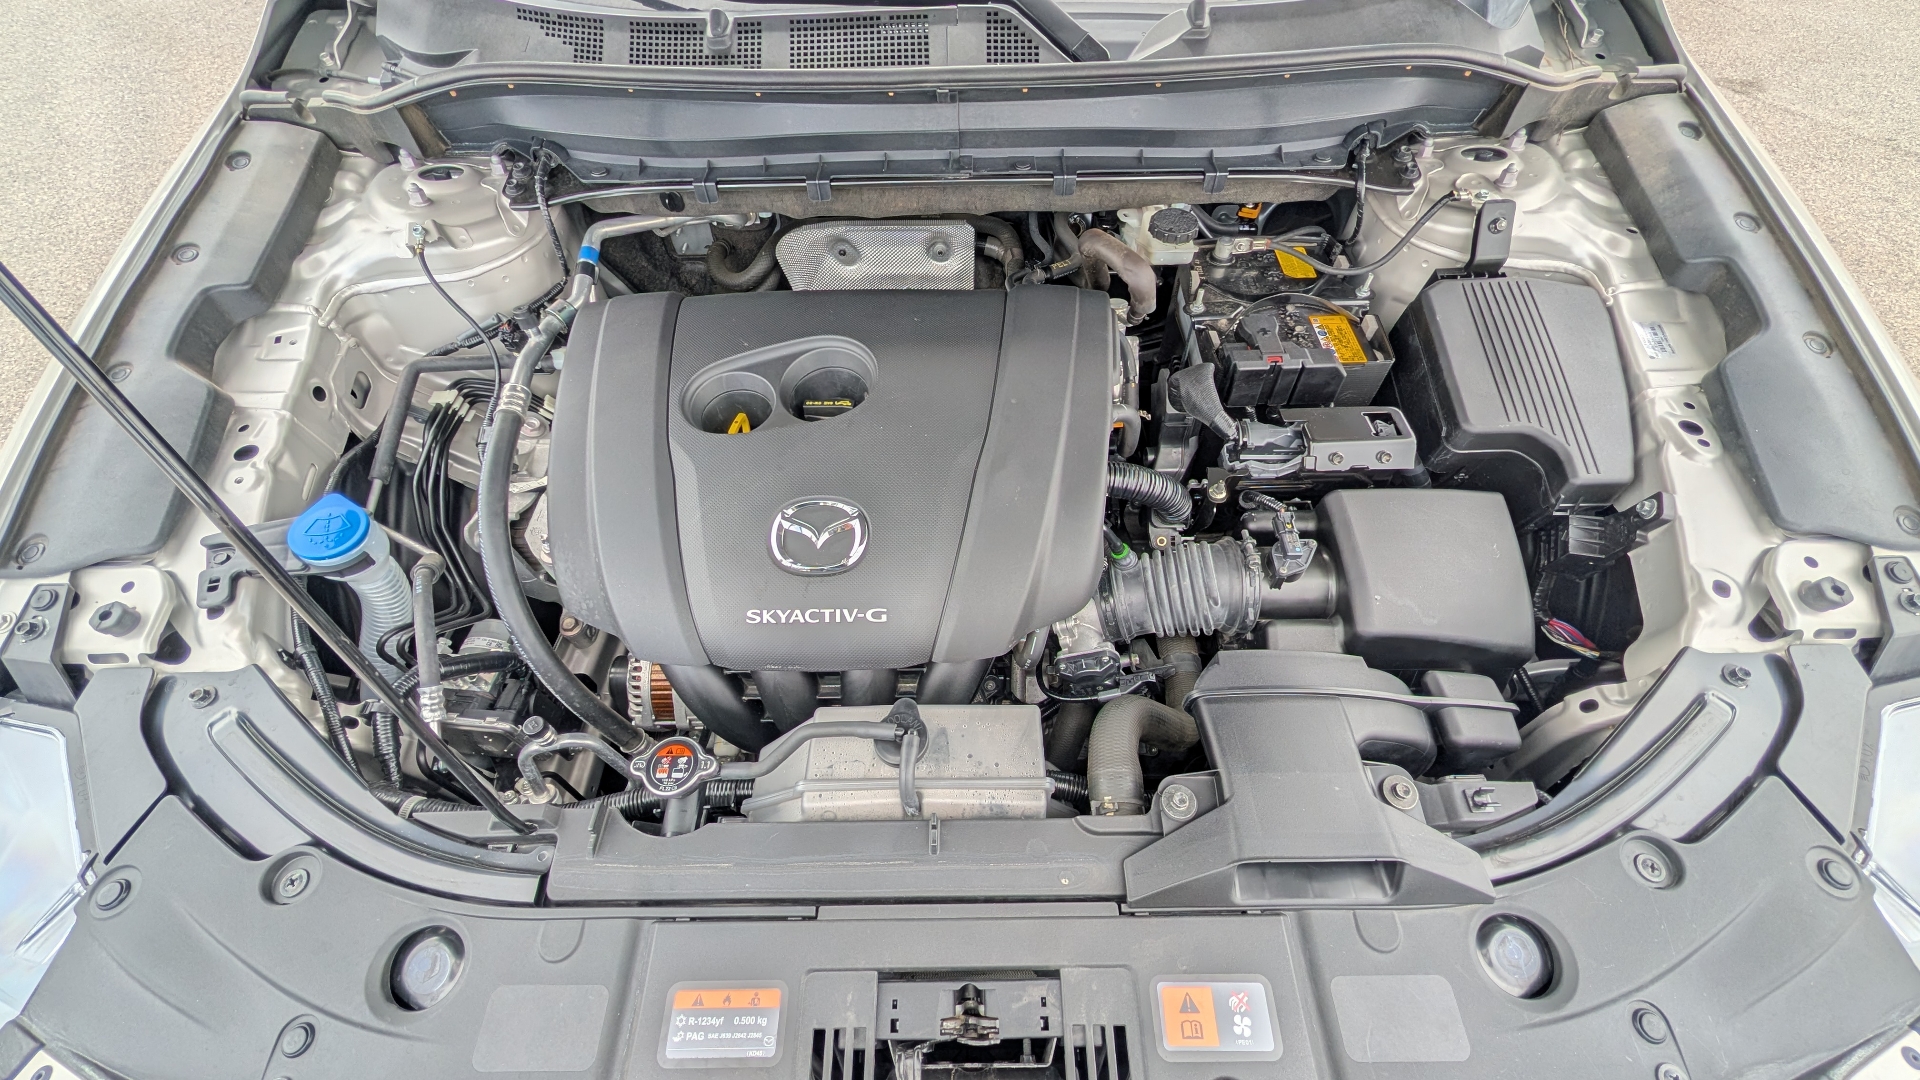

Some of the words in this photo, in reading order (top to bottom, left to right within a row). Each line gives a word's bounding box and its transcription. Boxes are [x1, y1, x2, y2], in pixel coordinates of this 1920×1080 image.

[745, 608, 888, 624] SKYACTIV-G
[688, 1016, 724, 1027] R-1234yf
[733, 1016, 755, 1025] 0.500
[757, 1016, 768, 1027] kg
[686, 1031, 705, 1041] PAG
